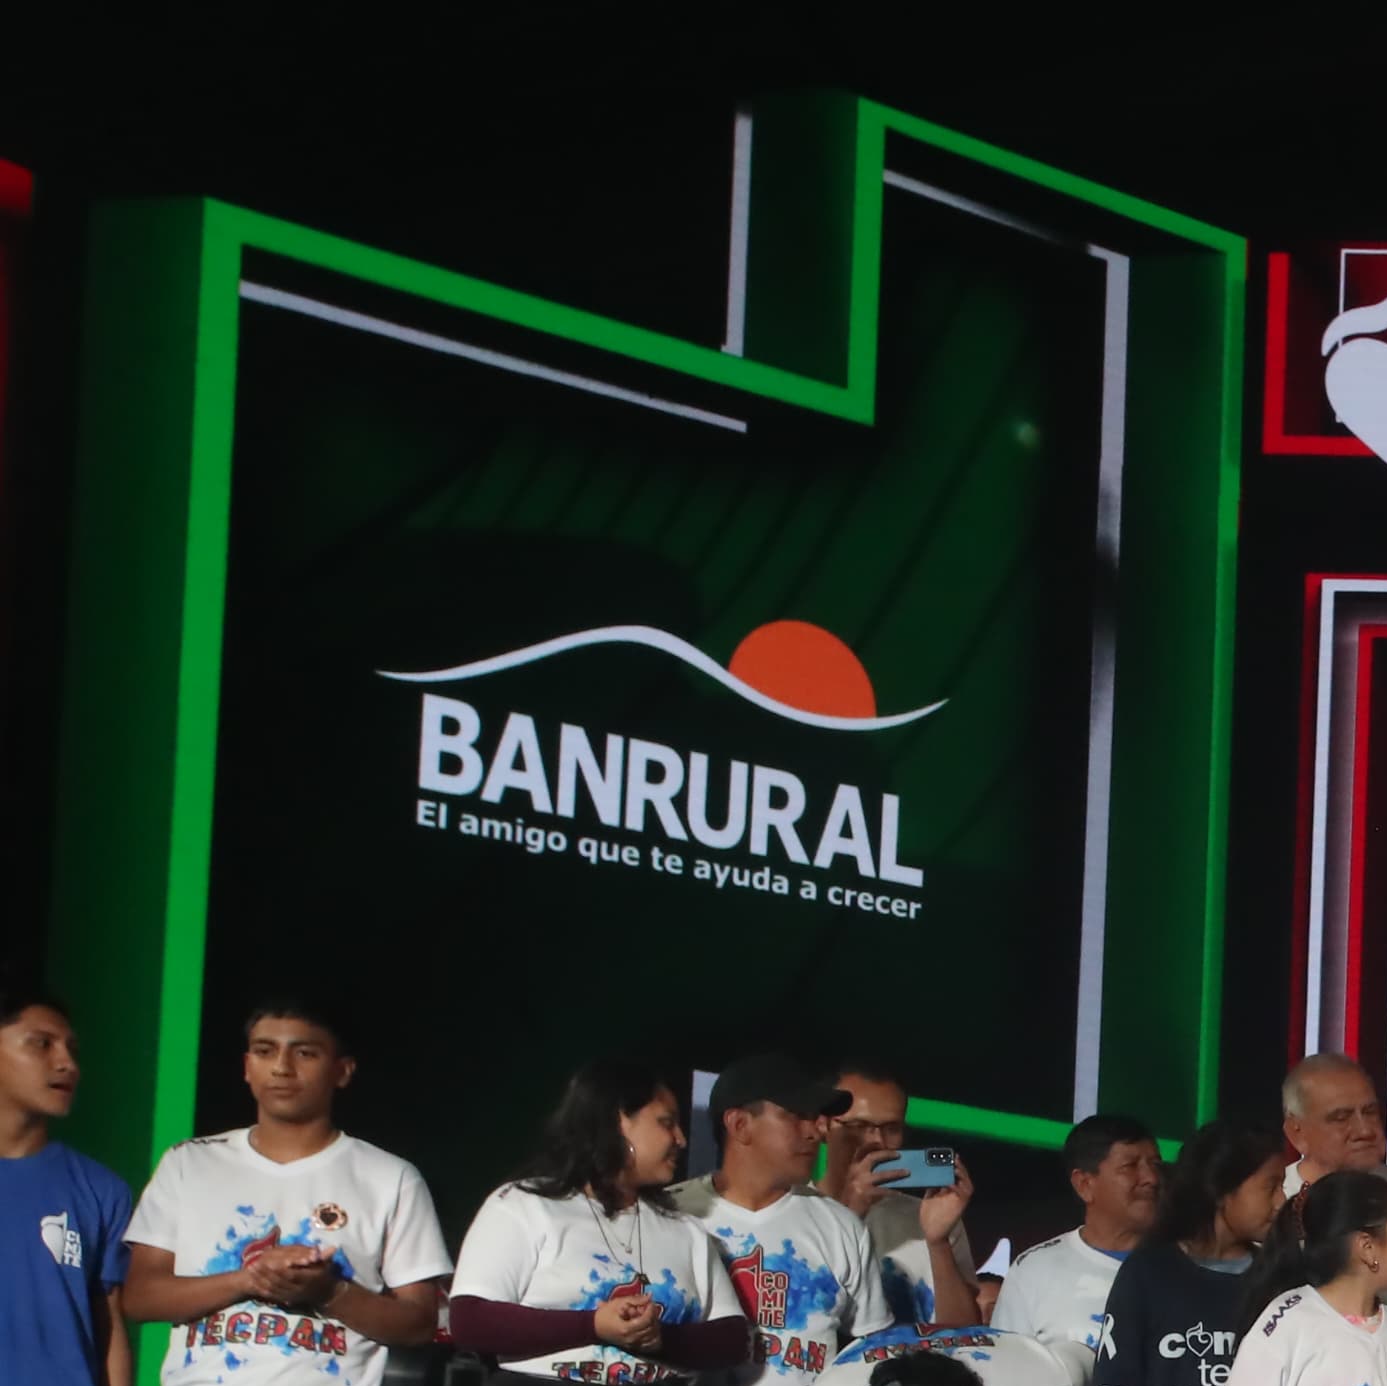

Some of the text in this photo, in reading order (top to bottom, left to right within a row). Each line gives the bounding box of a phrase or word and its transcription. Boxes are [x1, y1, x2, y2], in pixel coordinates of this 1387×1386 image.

[418, 692, 924, 888] BANRURAL
[416, 799, 922, 919] El amigo que te ayuda a crecer
[760, 1272, 788, 1290] CO
[761, 1290, 786, 1308] MI
[186, 1311, 347, 1356] TECPAN
[760, 1308, 785, 1327] TE
